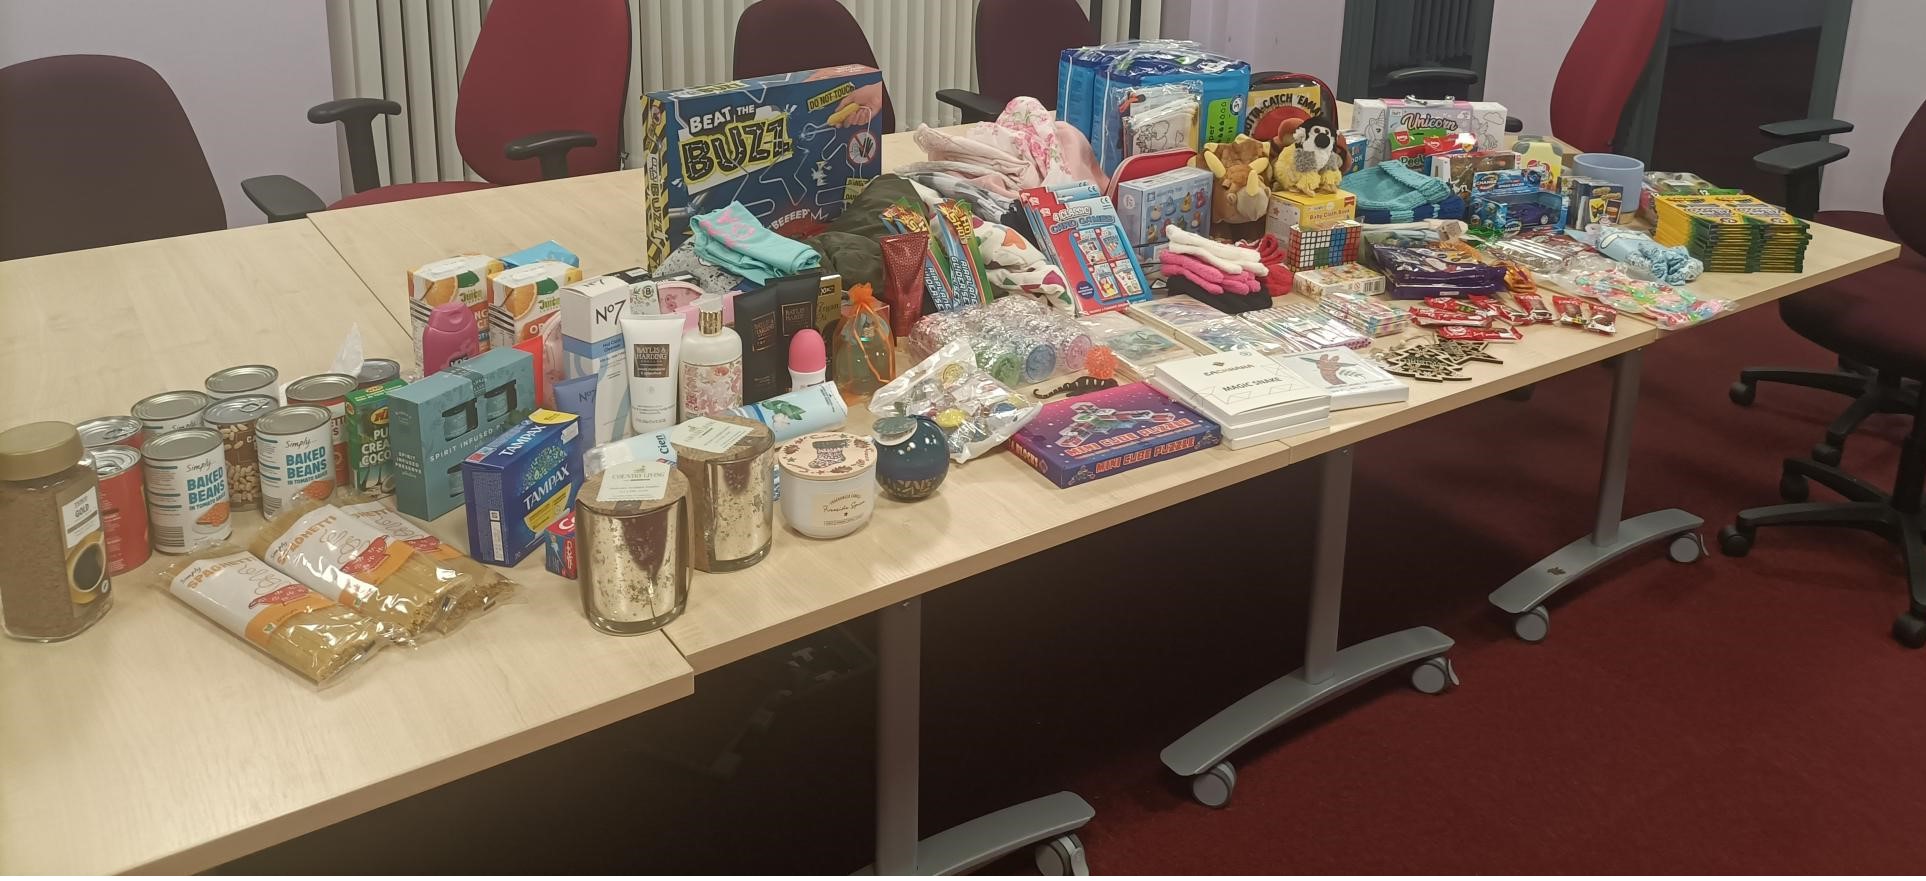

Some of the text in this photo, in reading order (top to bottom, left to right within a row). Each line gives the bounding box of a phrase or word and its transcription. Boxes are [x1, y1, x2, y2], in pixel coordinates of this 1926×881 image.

[809, 100, 819, 111] DO
[689, 105, 755, 135] BEAT THE
[1400, 112, 1458, 131] Unicorn
[682, 118, 790, 181] BUZZ
[1059, 206, 1092, 219] CLASSIC
[1050, 215, 1115, 234] CARD GAMES
[1222, 377, 1282, 392] MAGIC SNAKE
[361, 439, 391, 454] CREA
[429, 428, 493, 462] SPIRIT INFUSED
[498, 424, 547, 456] TAMPAX
[656, 434, 669, 455] Cien
[1064, 418, 1195, 457] MINI CUBE PUZZLE
[286, 446, 326, 466] BAKED
[361, 449, 392, 466] COCO
[399, 451, 416, 460] SPIRIT
[1096, 437, 1196, 473] MINI CUBE PUZZLE
[187, 467, 223, 491] BAKED
[287, 459, 328, 479] BEANS
[643, 471, 665, 479] LIVING
[188, 480, 225, 504] BEANS
[523, 464, 570, 511] TAMPAX
[75, 503, 90, 518] GOLD
[187, 557, 253, 589] SPAGHETTI
